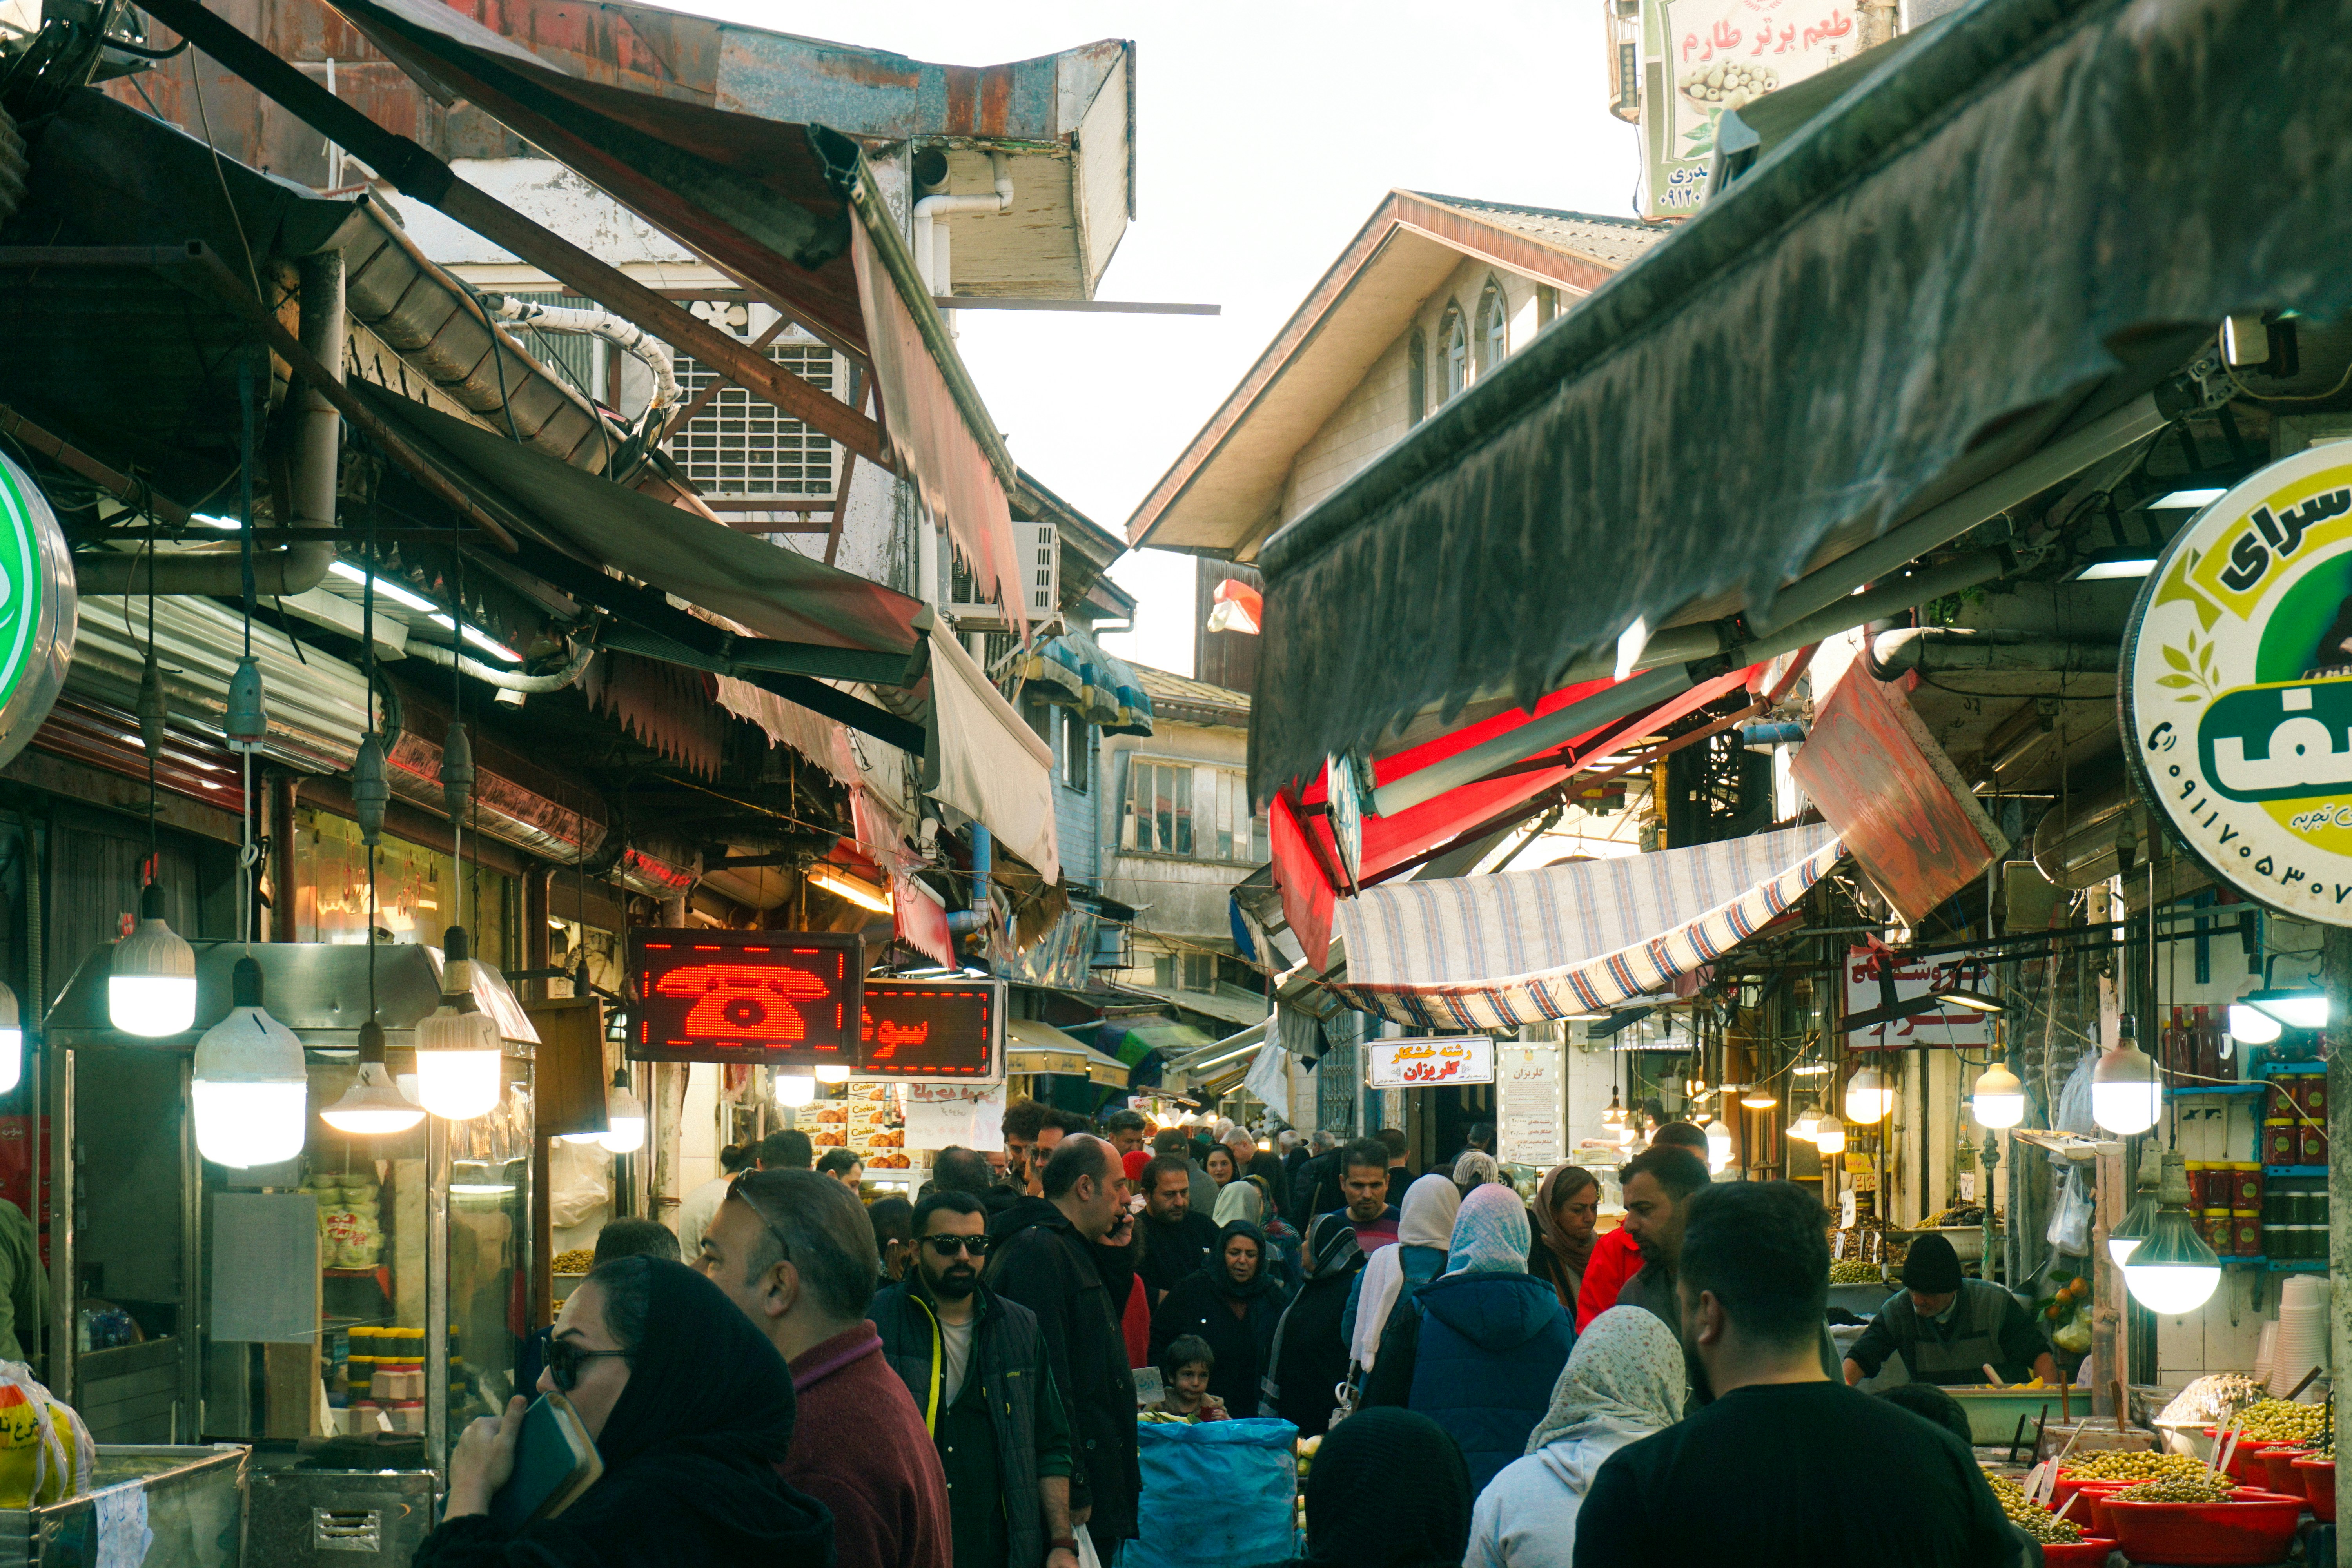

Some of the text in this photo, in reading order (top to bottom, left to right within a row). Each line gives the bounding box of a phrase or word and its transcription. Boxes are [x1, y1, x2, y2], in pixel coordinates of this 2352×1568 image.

[1682, 9, 1853, 62] طعم برتر طارم
[1670, 165, 1708, 184] دری
[1661, 187, 1704, 206] ۰۹۱۲۰
[1391, 1044, 1472, 1064] رشته خشکار
[1403, 1060, 1460, 1081] گلریزان
[1514, 1067, 1544, 1079] گلریزان
[852, 1083, 877, 1092] Cookie
[800, 1103, 824, 1112] Cookie
[852, 1105, 877, 1114] Cookie
[851, 1127, 875, 1137] Cookie
[14, 1417, 39, 1441] مرغ
